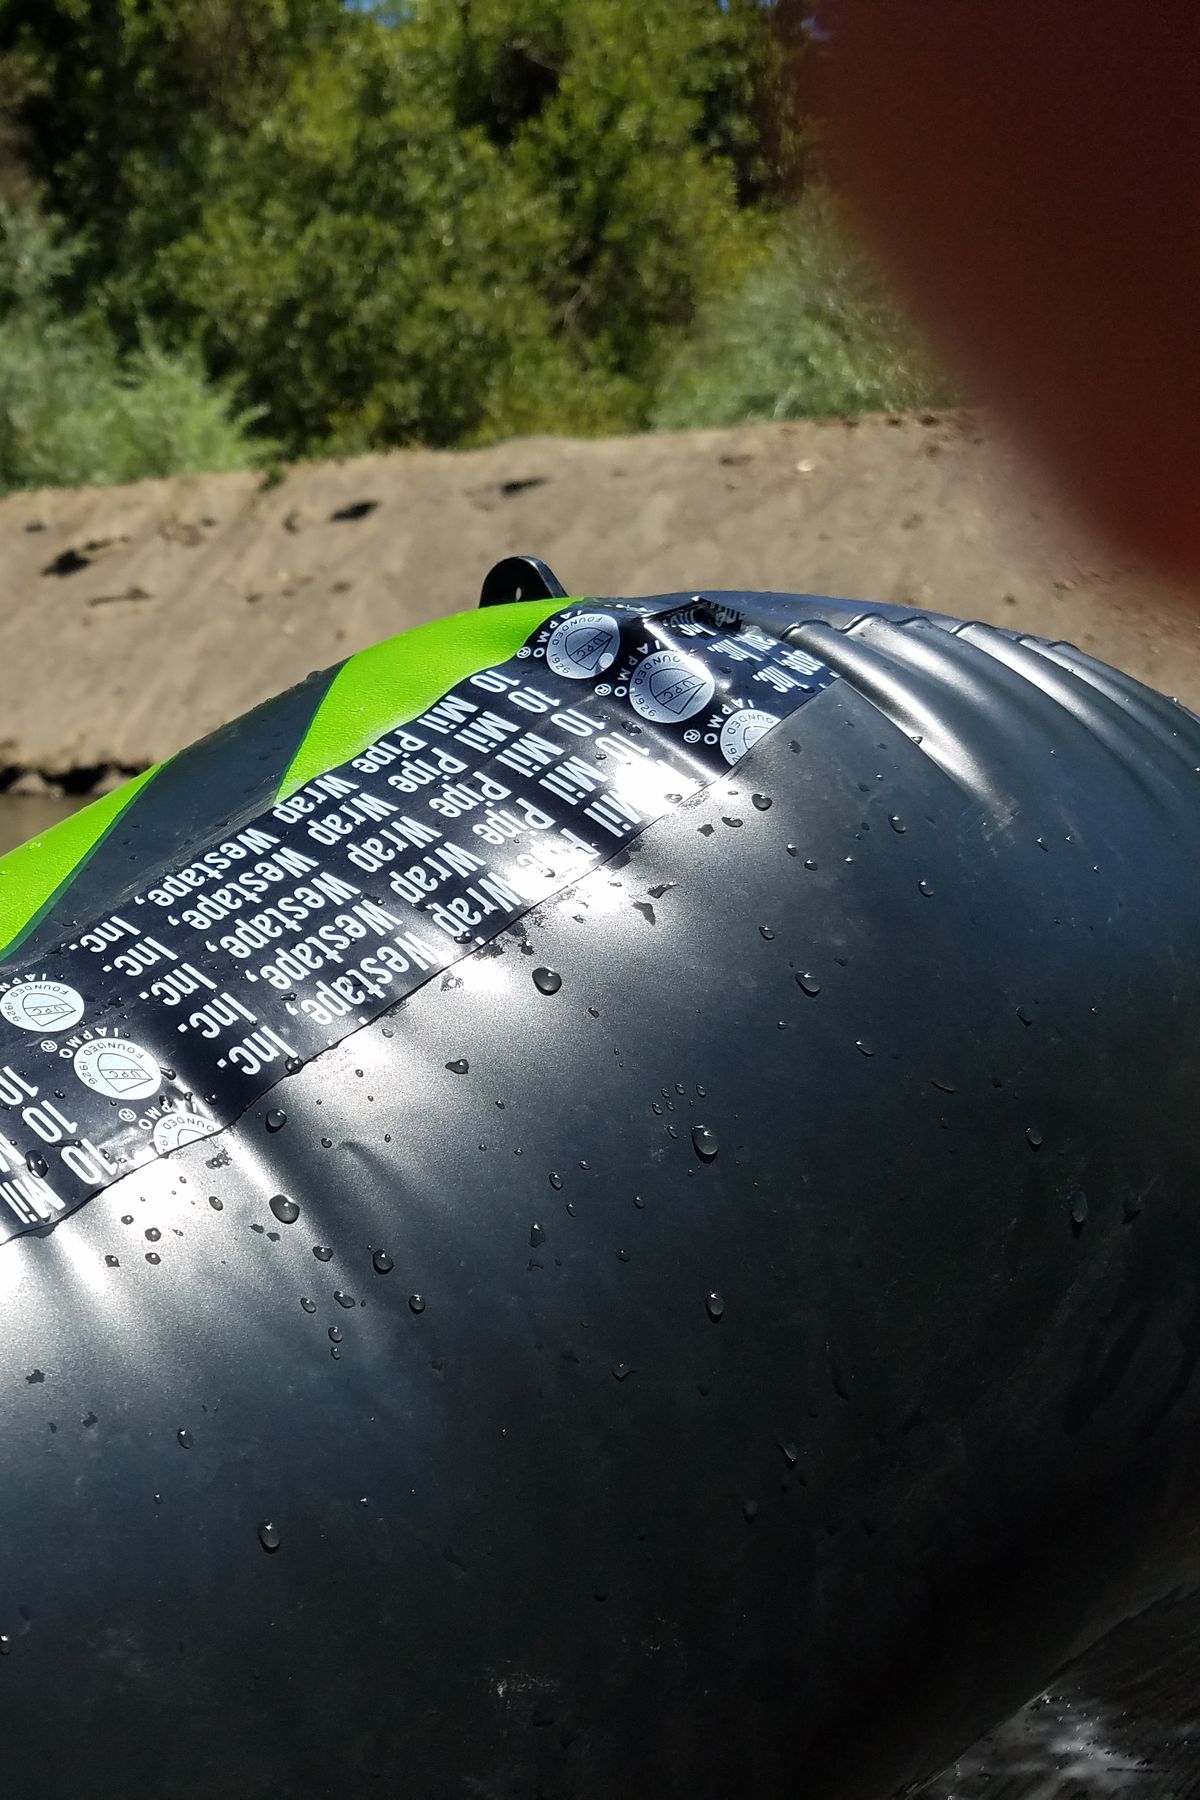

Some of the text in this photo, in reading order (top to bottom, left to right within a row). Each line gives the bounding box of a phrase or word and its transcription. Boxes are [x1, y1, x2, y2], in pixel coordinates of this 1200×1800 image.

[533, 610, 582, 658] IAPMO
[551, 615, 603, 674] FOUNDED 1926
[575, 636, 605, 658] UPC
[614, 640, 661, 698] IAPMO
[633, 652, 682, 717] OUNDED 1926
[663, 680, 696, 699] UPC
[703, 698, 755, 745] IAPMO
[594, 731, 650, 761] 10
[538, 755, 610, 806] Mil
[68, 670, 520, 953] 10 Mil Pipe Wrap Westape, Inc.
[102, 686, 560, 977] 10 Mil Pipe Wrap Westape, Inc.
[472, 797, 556, 845] Pipe
[139, 709, 605, 1006] 10 Mil Pipe Wrap Westape, Inc.
[389, 841, 487, 903] Wrap
[432, 871, 523, 938] Wrap
[244, 900, 403, 990] Westape,
[285, 931, 439, 1025] Westape,
[4, 984, 69, 1023] FOUNDED 1926
[31, 1006, 65, 1016] UPC
[177, 992, 258, 1038] Inc.
[59, 1026, 119, 1059] IAPMO
[79, 1041, 144, 1086] FOUNDED 1926
[217, 1025, 300, 1075] Inc.
[108, 1070, 143, 1080] UPC
[22, 1100, 79, 1143] 10
[60, 1138, 119, 1185] 10
